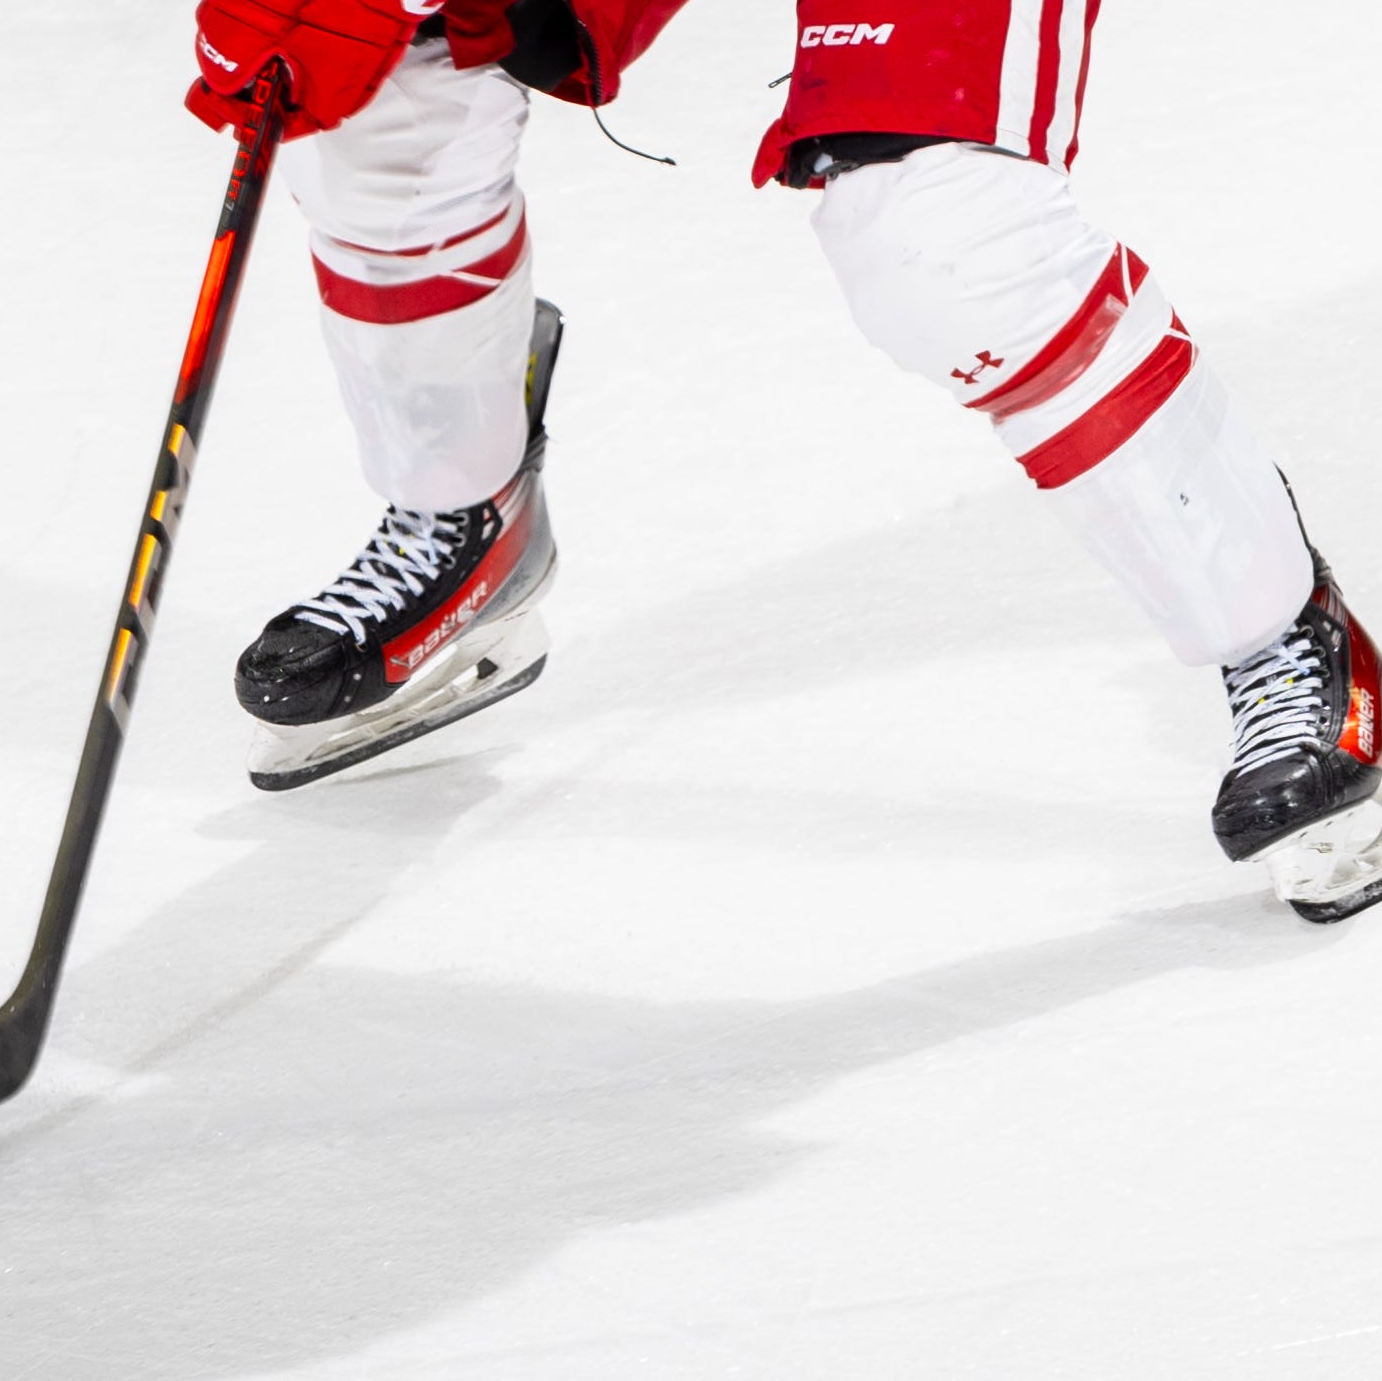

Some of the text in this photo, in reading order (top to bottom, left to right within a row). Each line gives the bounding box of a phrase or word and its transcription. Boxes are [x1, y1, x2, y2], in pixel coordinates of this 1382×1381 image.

[800, 23, 895, 49] CCM
[406, 580, 488, 669] BAUER
[1357, 687, 1375, 759] BAUER
